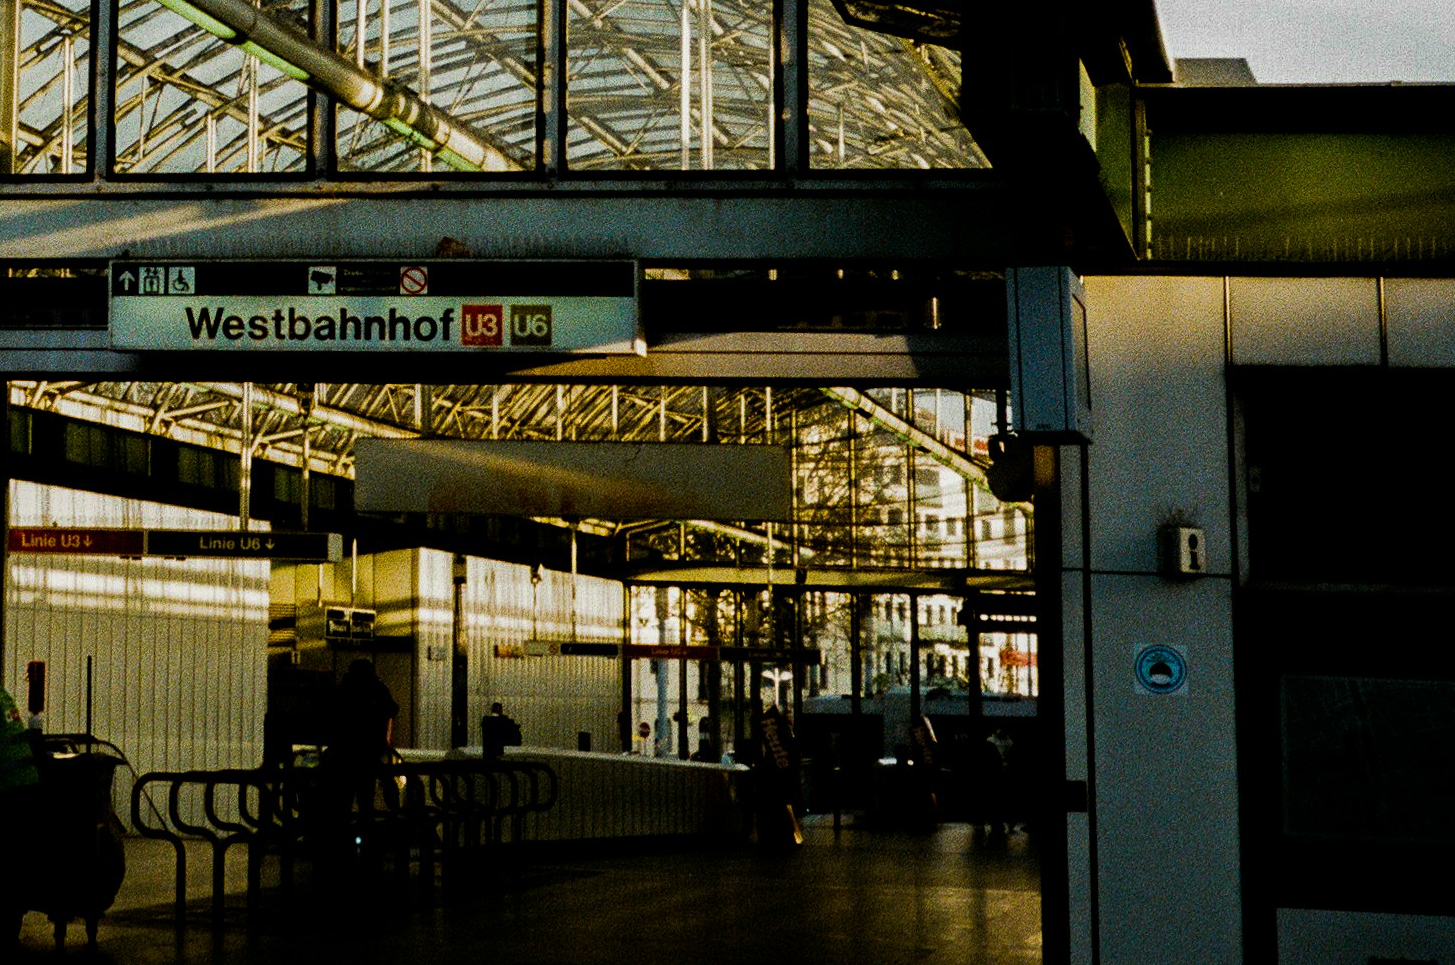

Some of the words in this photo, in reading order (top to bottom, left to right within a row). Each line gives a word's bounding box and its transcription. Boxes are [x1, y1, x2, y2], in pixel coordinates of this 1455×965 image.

[185, 307, 454, 341] Westbahnhof
[465, 314, 498, 336] U3
[514, 314, 548, 336] U6
[21, 532, 56, 547] Linie
[61, 534, 80, 547] U3
[199, 535, 236, 550] Linie
[240, 537, 260, 551] U6
